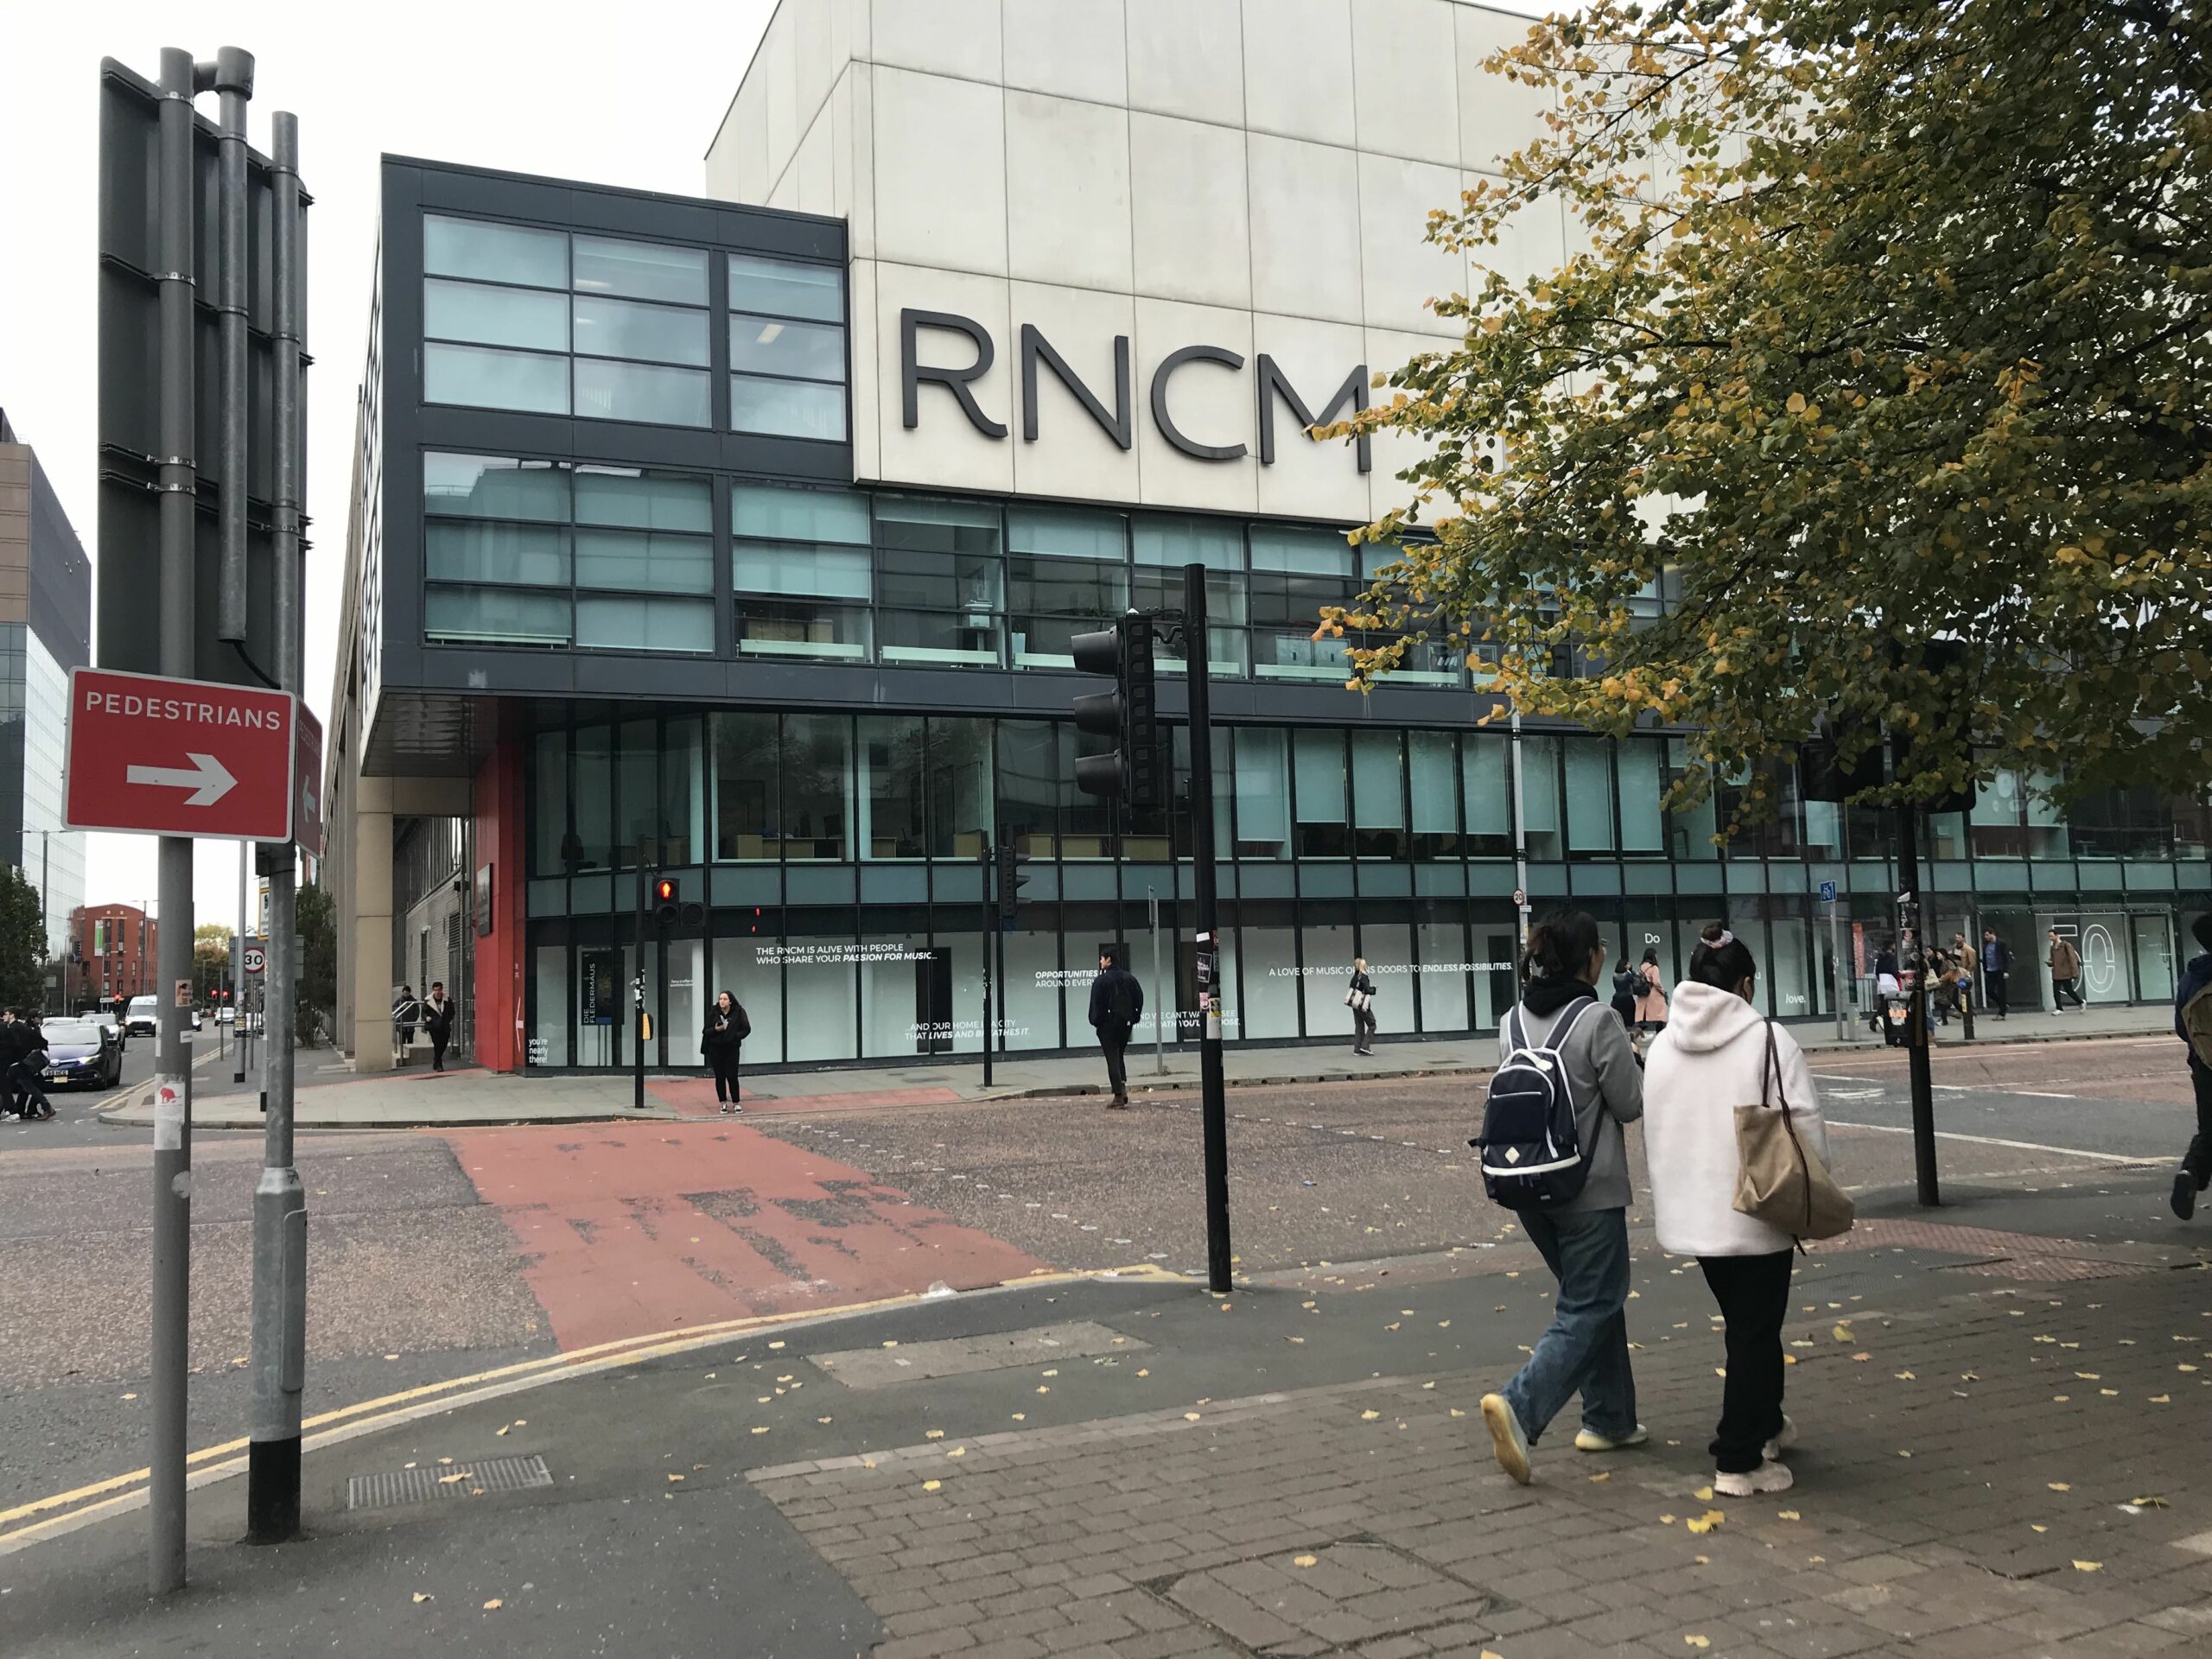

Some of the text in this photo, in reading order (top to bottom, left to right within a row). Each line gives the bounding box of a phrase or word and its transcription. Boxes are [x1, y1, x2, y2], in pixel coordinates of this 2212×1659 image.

[900, 308, 1372, 473] RNCM
[86, 691, 281, 730] PEDESTRIANS
[1644, 933, 1660, 944] Do
[756, 947, 775, 956] THE
[777, 946, 804, 955] RNCM
[817, 945, 842, 954] ALIVE
[844, 944, 868, 953] WITH
[869, 944, 904, 952] PEOPLE
[245, 955, 264, 966] 30
[756, 957, 780, 965] WHO
[782, 955, 813, 964] SHARE
[816, 954, 842, 963] YOUR
[842, 953, 882, 963] PASSION
[884, 952, 902, 962] FOR
[1035, 969, 1098, 979] OPPORTUNITIES
[1268, 962, 1513, 976] A LOVE OF MUSIC ONS DOORS TO ENDLESS POSSIBILITIES.
[1035, 979, 1071, 988] AROUND
[1785, 994, 1806, 1004] love.
[1221, 1009, 1236, 1018] SEE
[932, 1021, 951, 1031] OUR
[952, 1020, 979, 1030] HOME
[991, 1020, 998, 1028] A
[998, 1019, 1016, 1028] CITY
[1160, 1020, 1176, 1028] ATH
[1178, 1019, 1201, 1027] YOU'L
[906, 1032, 926, 1040] THAT
[929, 1031, 953, 1039] LIVES
[954, 1029, 975, 1039] AND
[976, 1027, 1020, 1038] BATHES
[528, 1037, 548, 1047] you're
[529, 1046, 549, 1057] nearly
